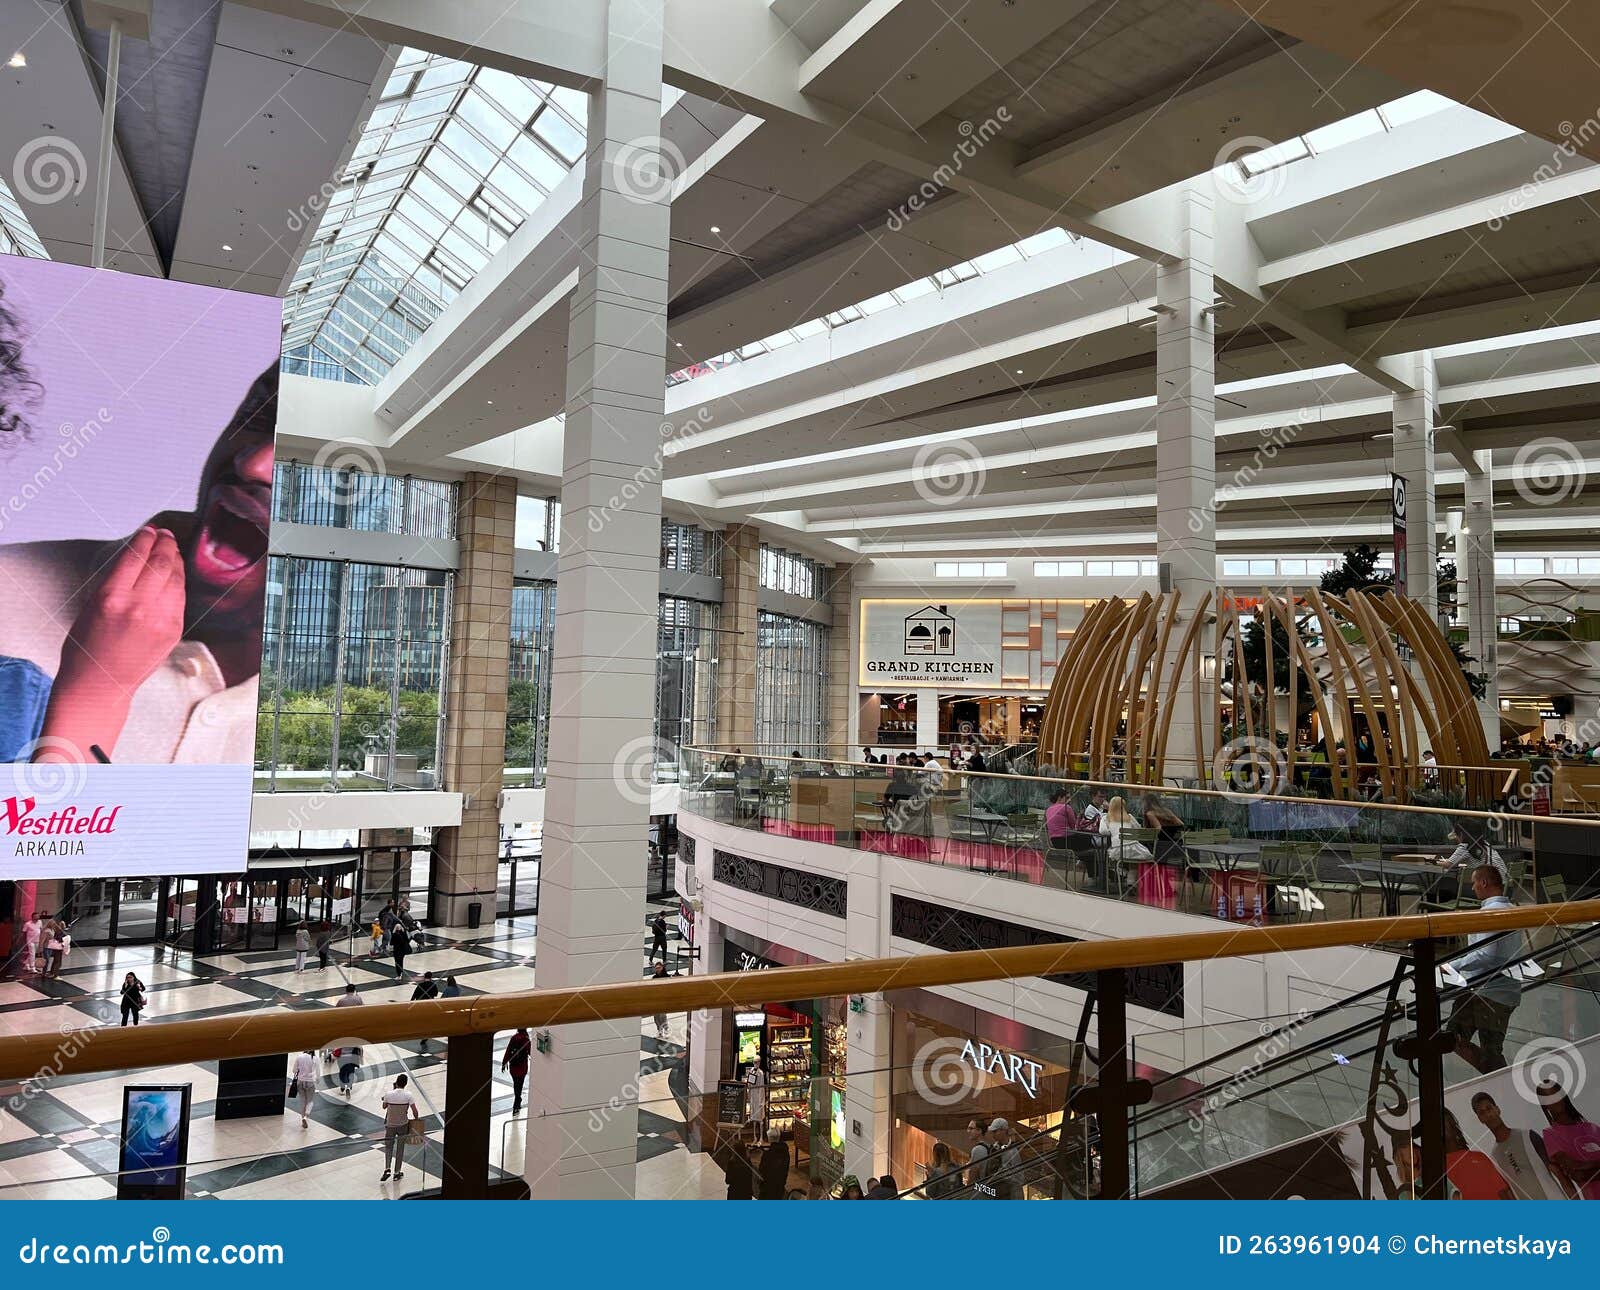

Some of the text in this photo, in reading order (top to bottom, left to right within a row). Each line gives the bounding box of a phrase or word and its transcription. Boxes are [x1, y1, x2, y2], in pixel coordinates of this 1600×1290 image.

[867, 661, 994, 673] GRAND KITCHEN
[15, 840, 85, 856] ARKADIA
[960, 1039, 1043, 1099] APART
